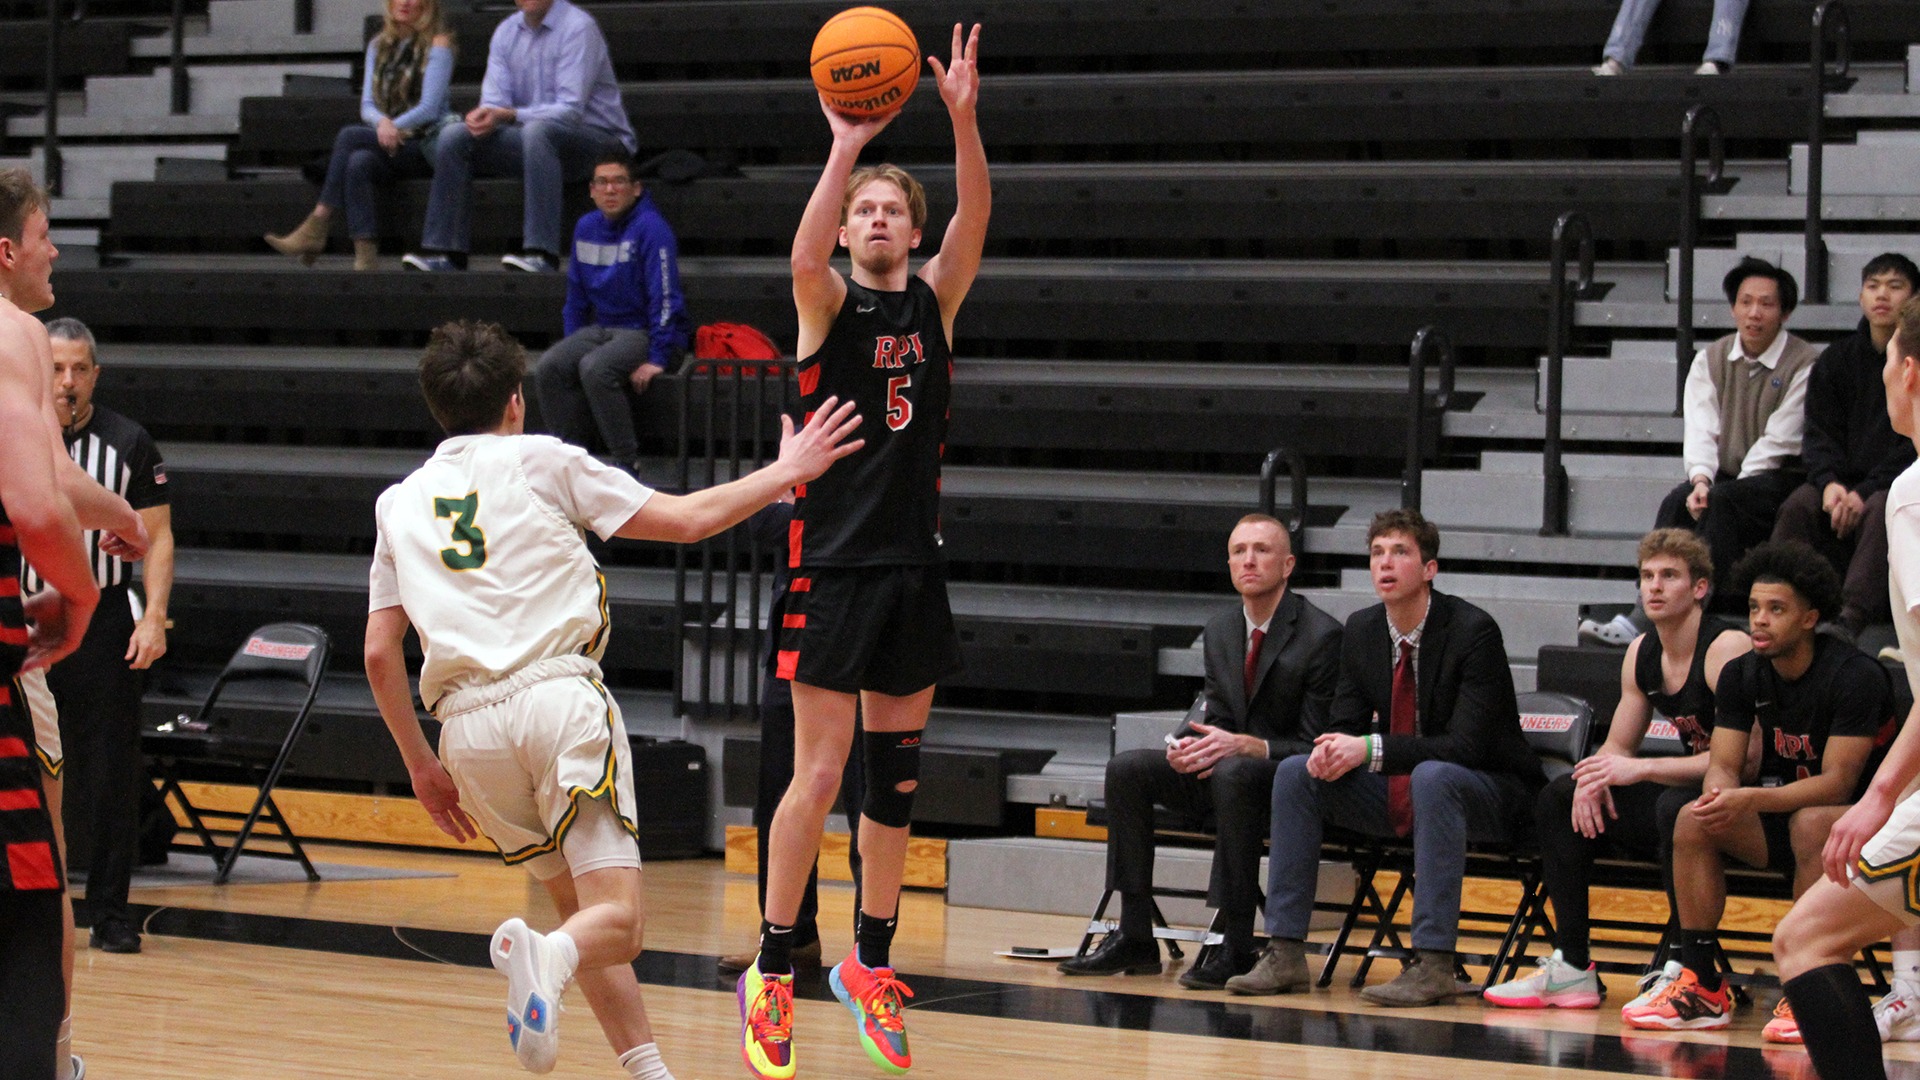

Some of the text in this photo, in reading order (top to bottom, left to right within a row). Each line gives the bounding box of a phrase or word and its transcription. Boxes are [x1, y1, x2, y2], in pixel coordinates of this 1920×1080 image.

[830, 59, 881, 83] NCAA
[830, 86, 902, 110] Wilson
[872, 331, 926, 369] RPI
[885, 373, 913, 432] 5
[432, 488, 489, 573] 3
